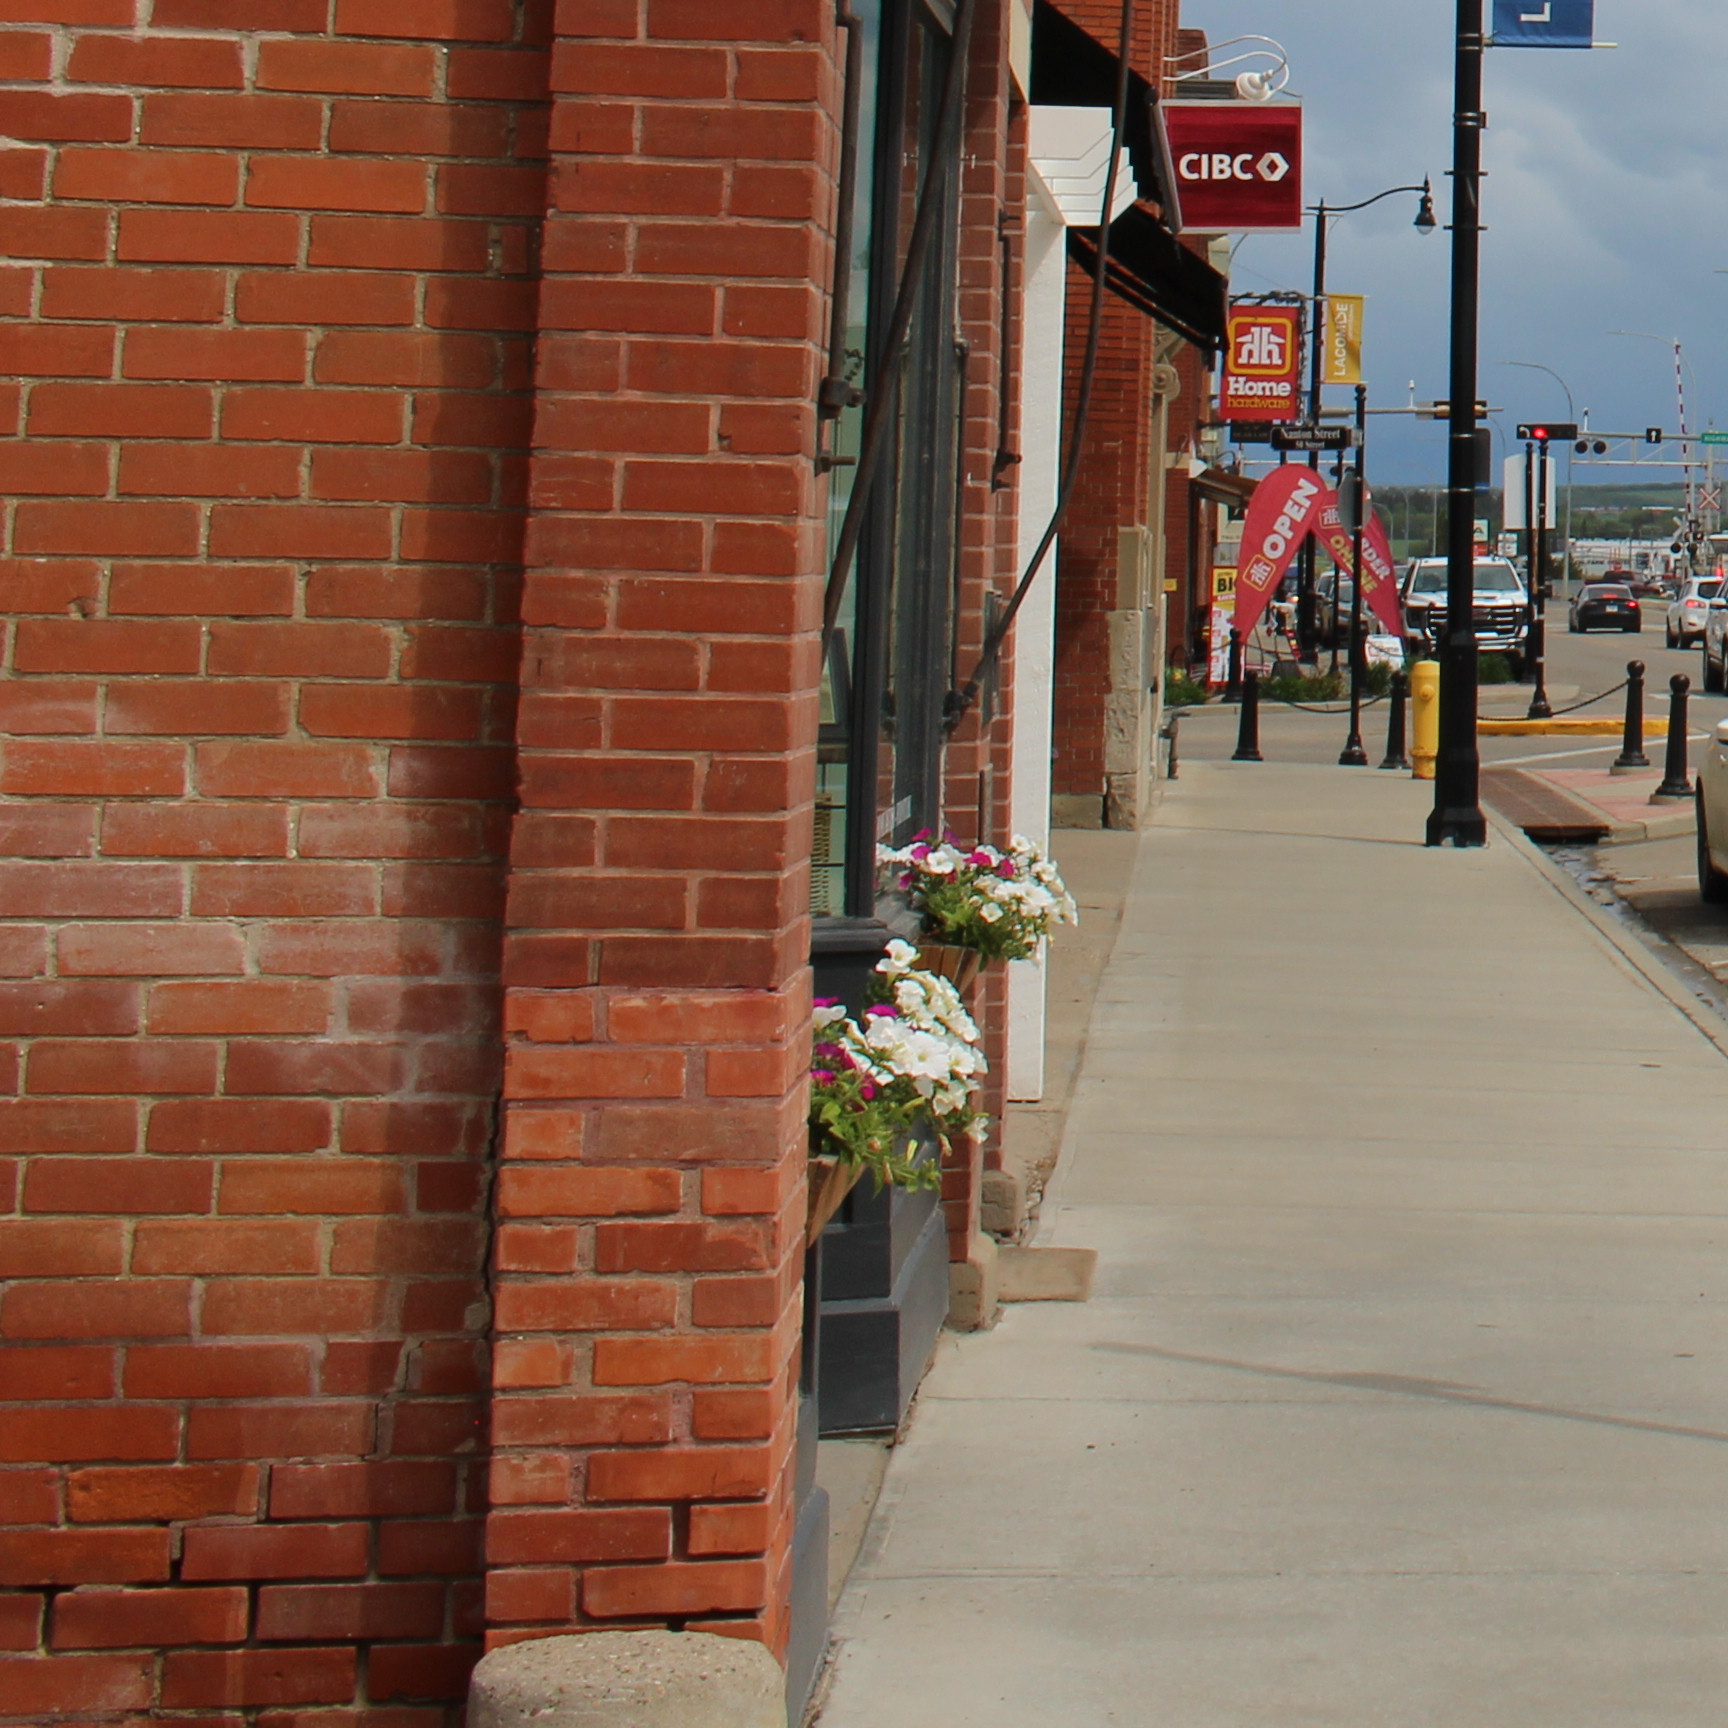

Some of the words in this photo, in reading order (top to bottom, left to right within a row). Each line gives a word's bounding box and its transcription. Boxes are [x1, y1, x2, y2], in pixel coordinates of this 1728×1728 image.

[1179, 153, 1253, 180] CIBC
[1227, 376, 1292, 397] Home
[1227, 396, 1290, 409] hardware
[1314, 429, 1340, 439] Street
[1263, 477, 1319, 559] OPEN
[1349, 535, 1391, 580] RDER
